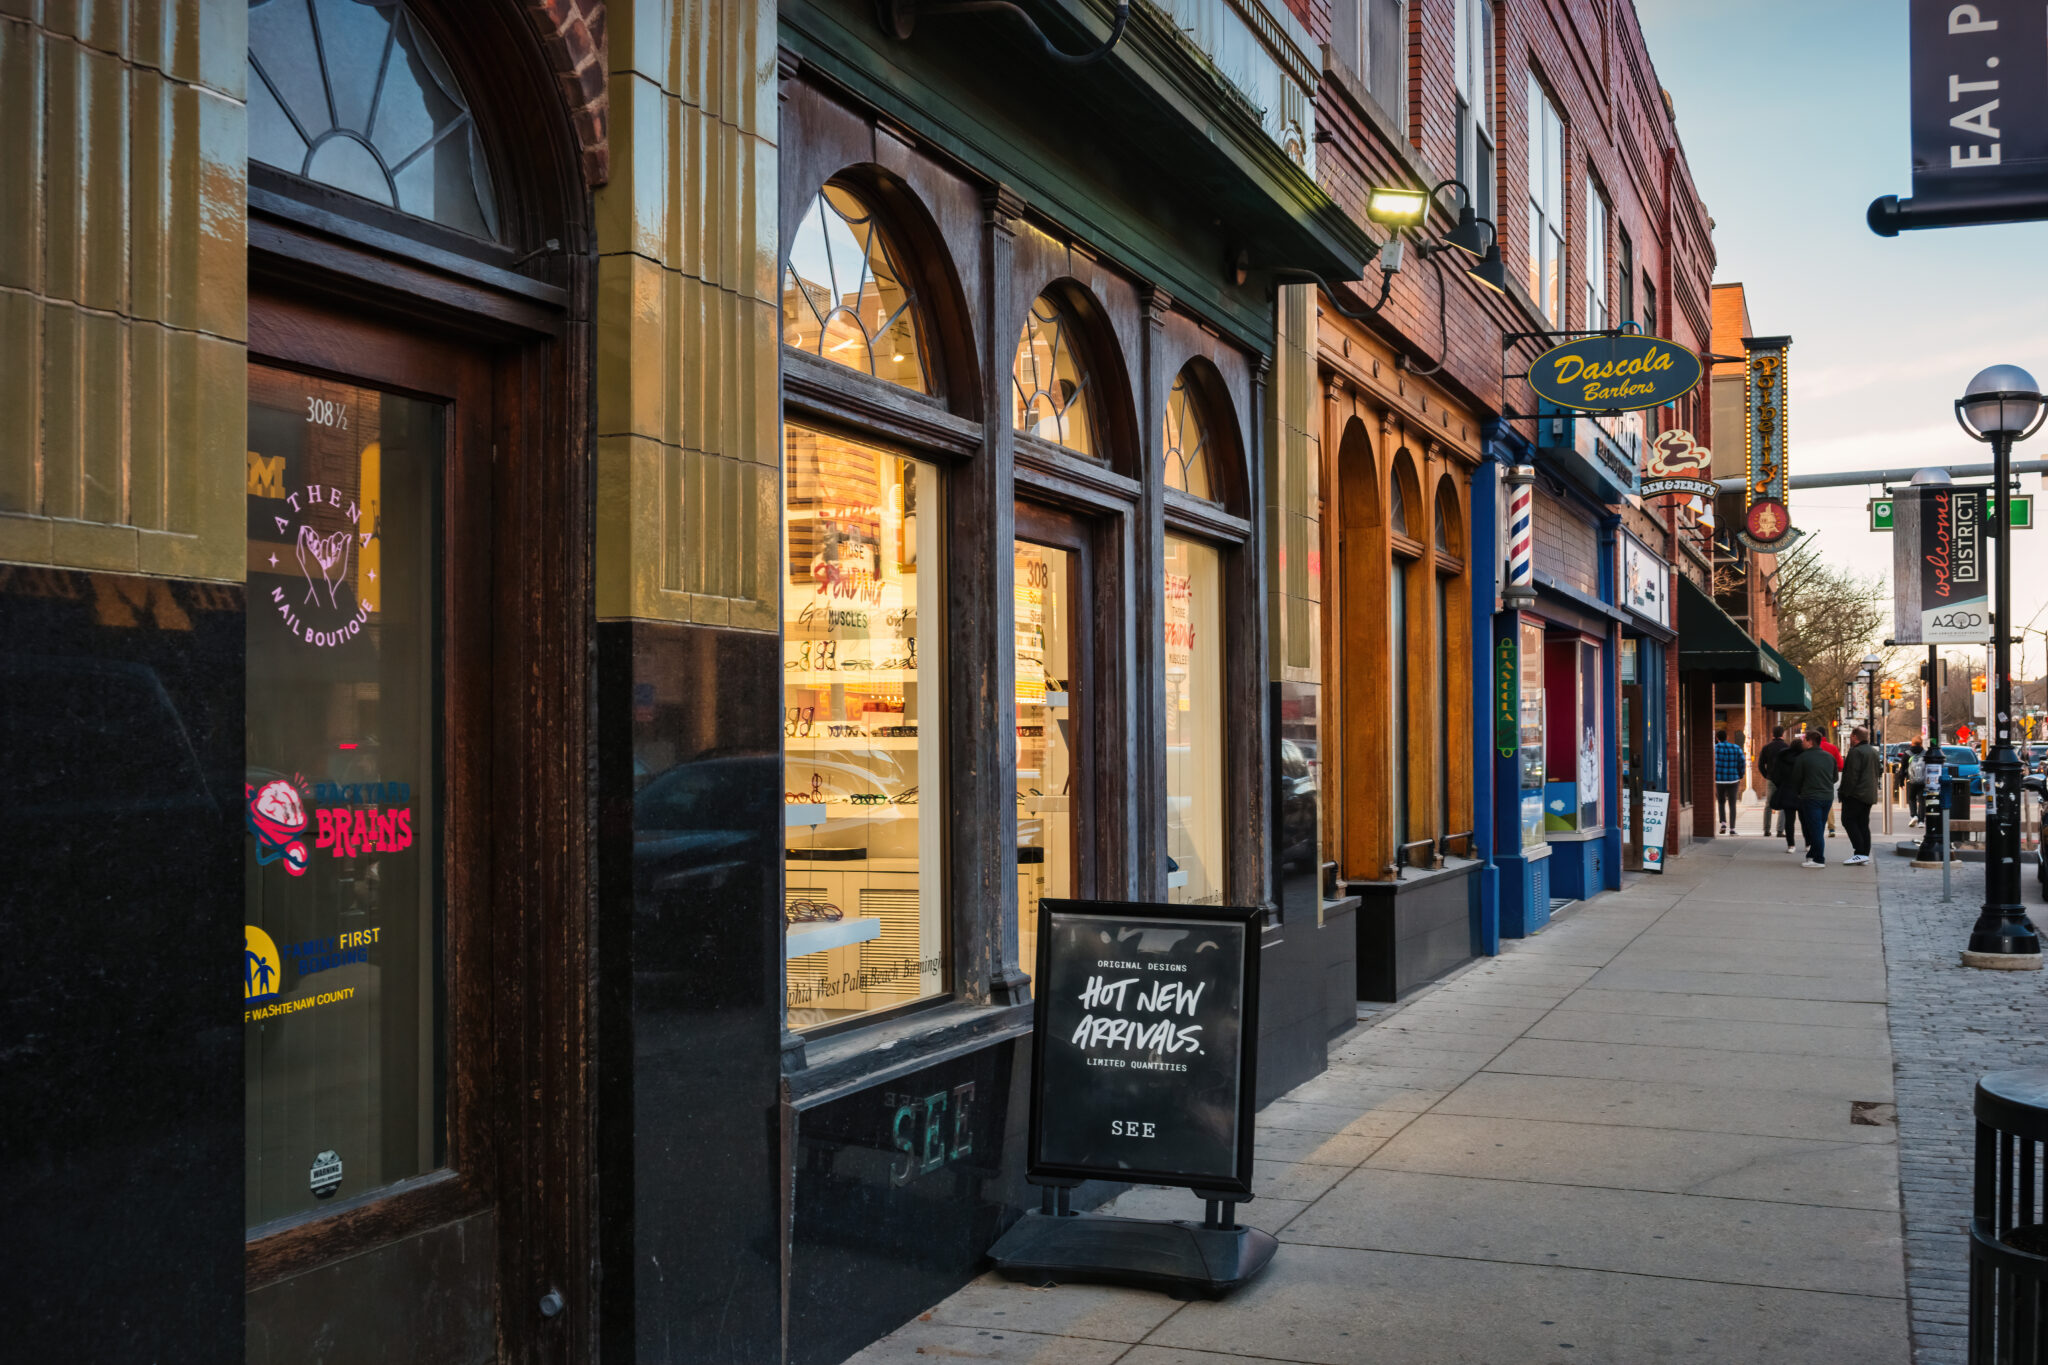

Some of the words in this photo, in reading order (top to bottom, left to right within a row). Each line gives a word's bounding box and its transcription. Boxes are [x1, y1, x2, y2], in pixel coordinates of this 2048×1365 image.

[1948, 56, 2001, 168] EAT.
[1554, 346, 1674, 385] Dascola
[1583, 378, 1656, 402] Barbers
[1753, 356, 1779, 494] Potbelly
[274, 484, 374, 549] ATHENA
[1926, 490, 1951, 597] welcome
[1958, 497, 1974, 577] DISTRICT
[1027, 560, 1048, 589] 308
[271, 586, 301, 636] NAIL
[304, 597, 374, 648] BOUTIQUE
[828, 609, 868, 629] MUSCLES
[1501, 650, 1515, 722] DASCOLA
[315, 781, 411, 805] BACKYARD
[315, 808, 412, 858] BRAINS
[283, 936, 336, 960] FAMILY
[340, 927, 381, 949] FIRST
[298, 948, 368, 976] BONDING
[817, 977, 840, 999] West
[842, 970, 868, 993] Palm
[869, 961, 898, 987] Beach
[1097, 960, 1142, 970] ORIGINAL
[1148, 963, 1187, 972] DESIGNS
[252, 996, 315, 1021] WASHTENAW
[317, 987, 355, 1005] COUNTY
[1078, 975, 1140, 1011] HOT
[1137, 981, 1206, 1016] NEW
[1071, 1014, 1206, 1056] ARRIVALS.
[1087, 1058, 1126, 1068] LIMITED
[1131, 1061, 1187, 1072] QUANTITIES
[889, 1081, 976, 1187] SEE
[1111, 1120, 1156, 1139] SEE
[313, 1164, 340, 1178] WARNING
